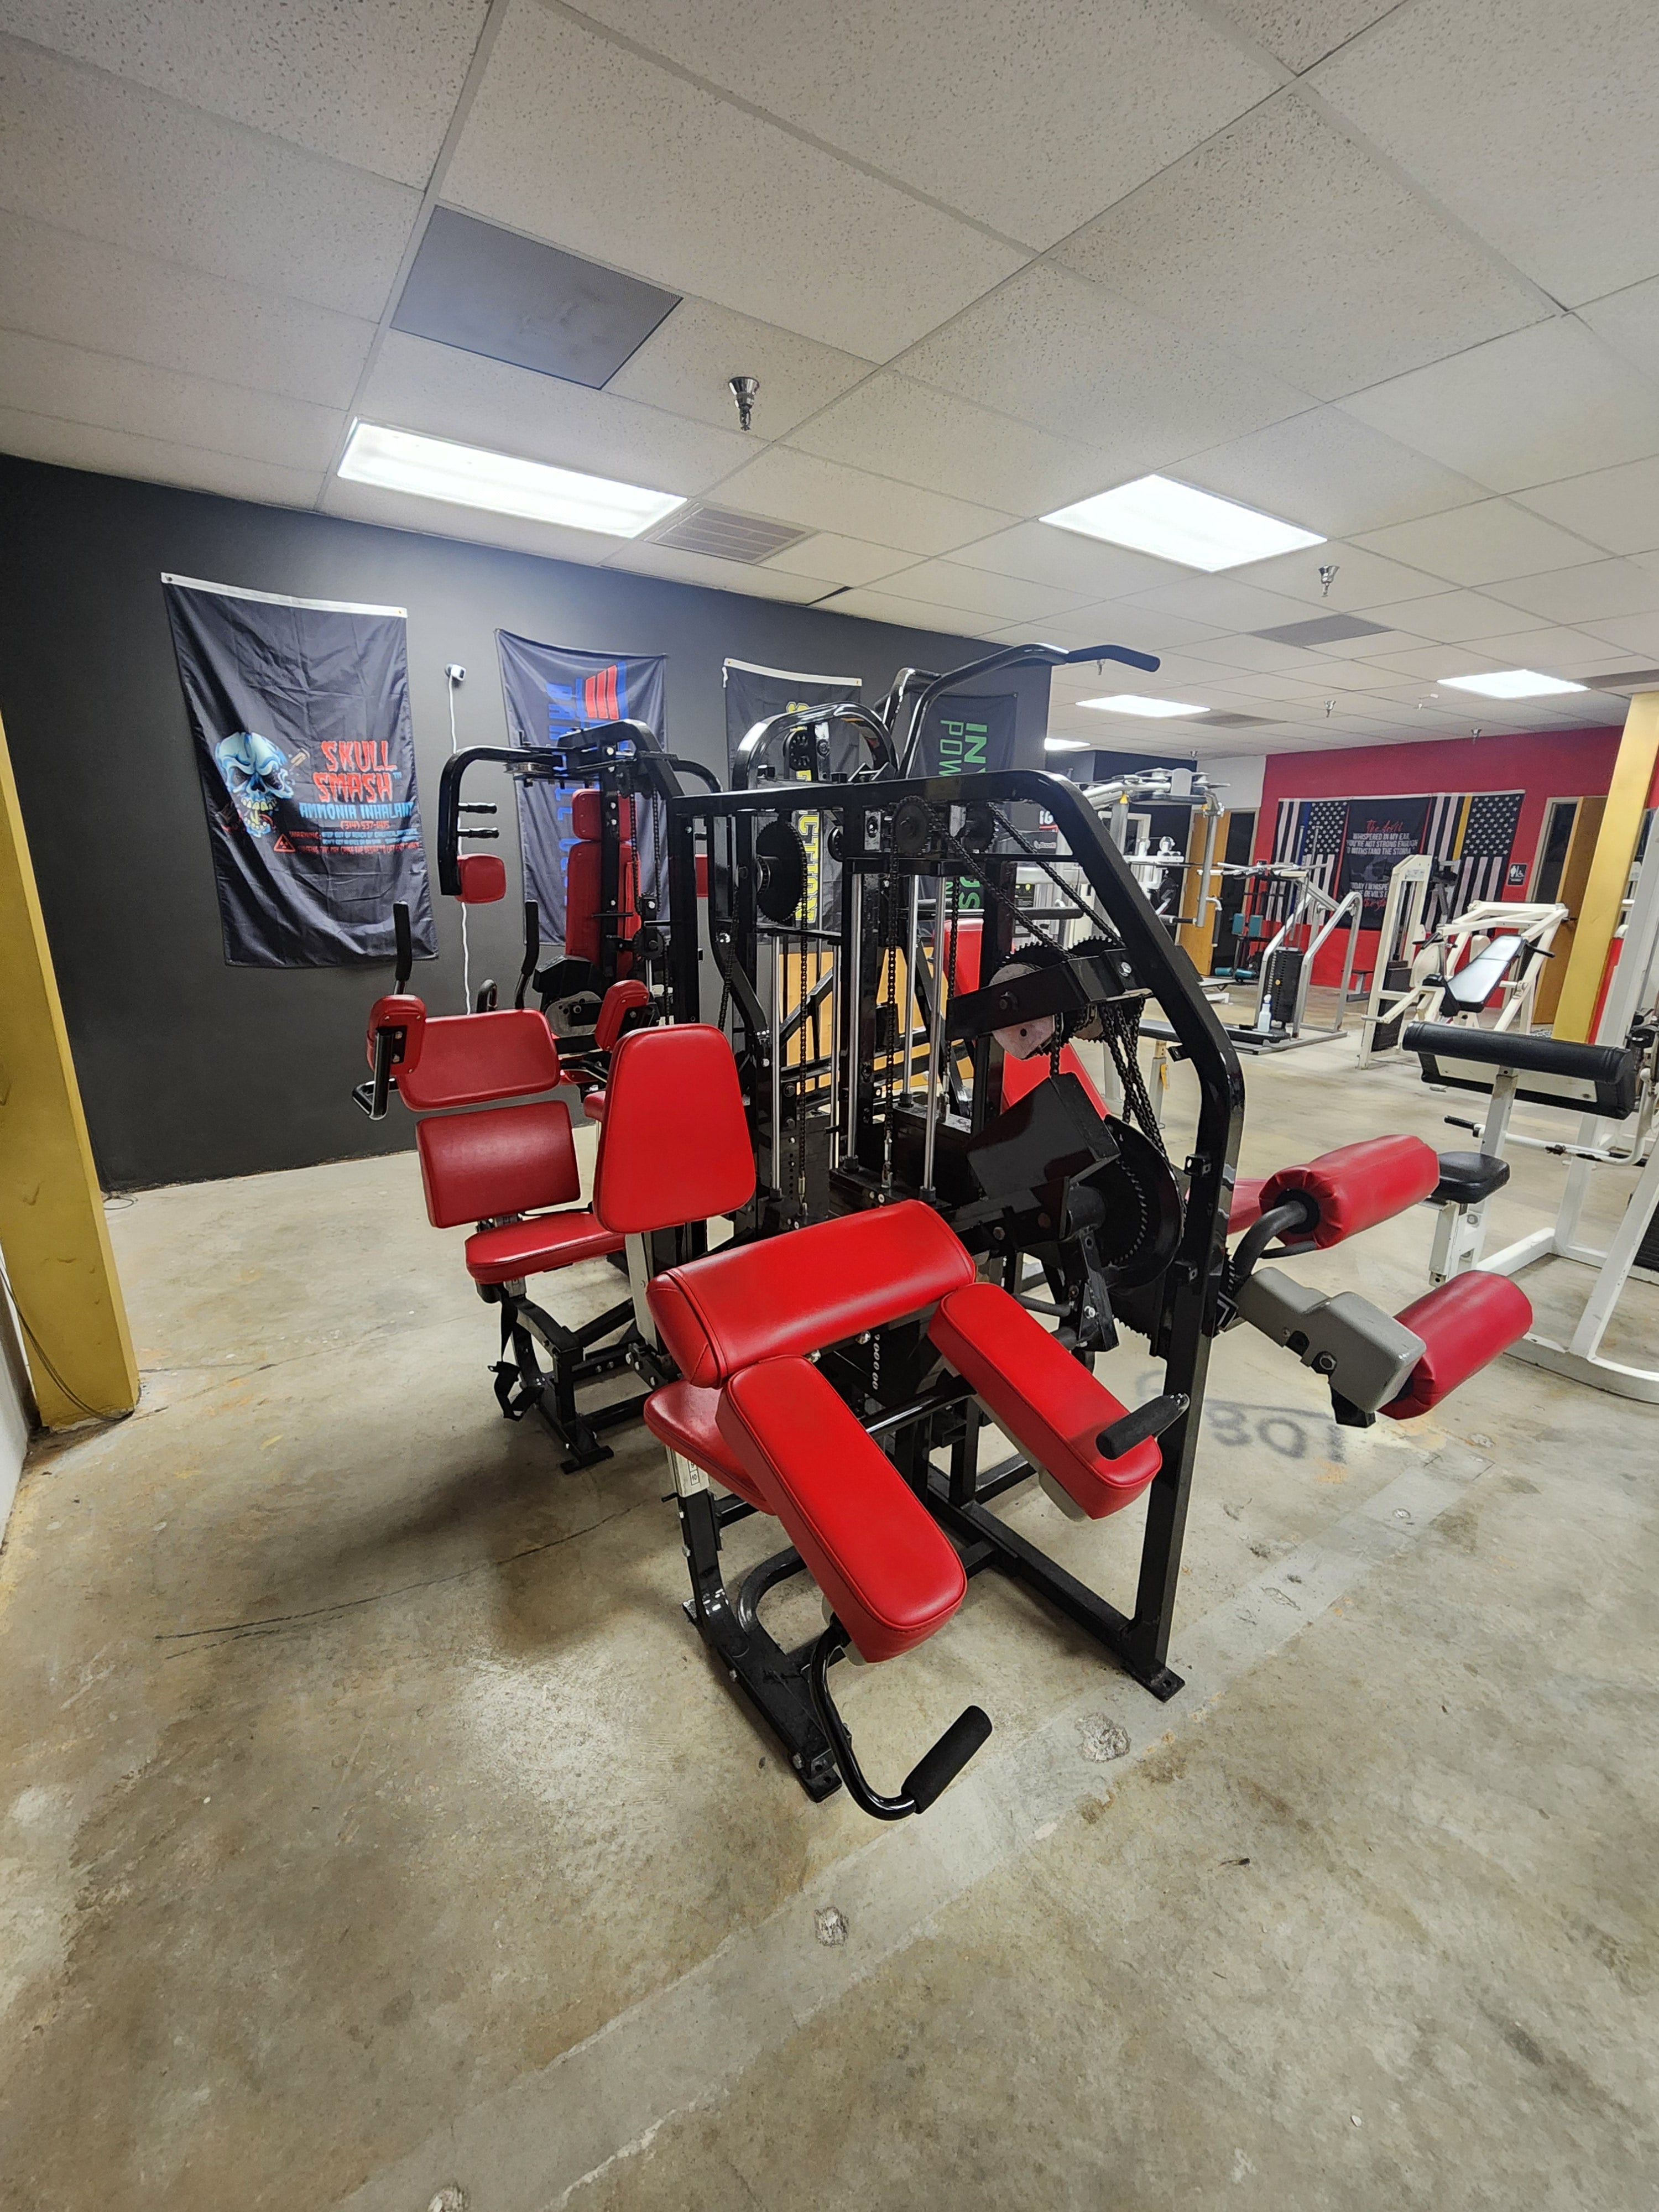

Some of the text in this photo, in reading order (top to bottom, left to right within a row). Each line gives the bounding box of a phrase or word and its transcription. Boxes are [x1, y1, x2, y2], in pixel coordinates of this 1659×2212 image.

[320, 740, 398, 772] SKULL
[313, 772, 393, 803] SMASH
[299, 802, 357, 820] AMMONIA
[1368, 883, 1389, 891] WHISPE
[692, 1473, 698, 1481] 10
